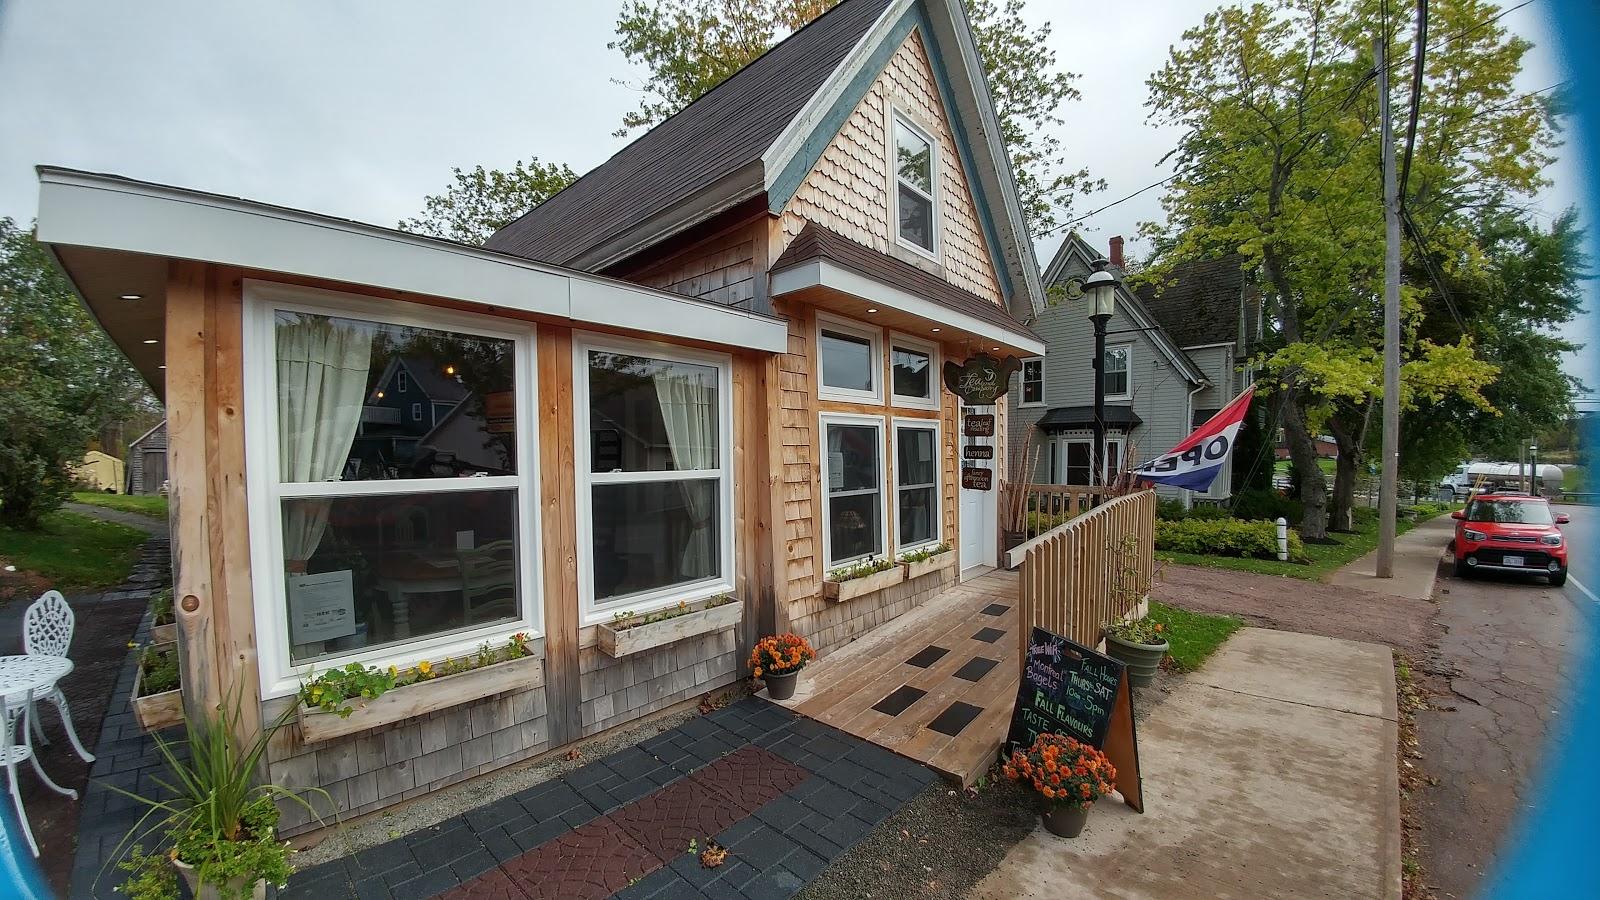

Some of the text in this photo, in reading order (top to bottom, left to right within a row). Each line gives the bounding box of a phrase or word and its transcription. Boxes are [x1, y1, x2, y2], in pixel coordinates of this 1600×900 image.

[965, 447, 991, 458] henna
[1026, 665, 1058, 690] Bagels
[1033, 660, 1064, 682] Montreal
[1093, 682, 1113, 701] SAT
[1022, 708, 1050, 731] TASTE
[1034, 689, 1054, 715] FALL
[1056, 703, 1094, 738] FLAVOURS
